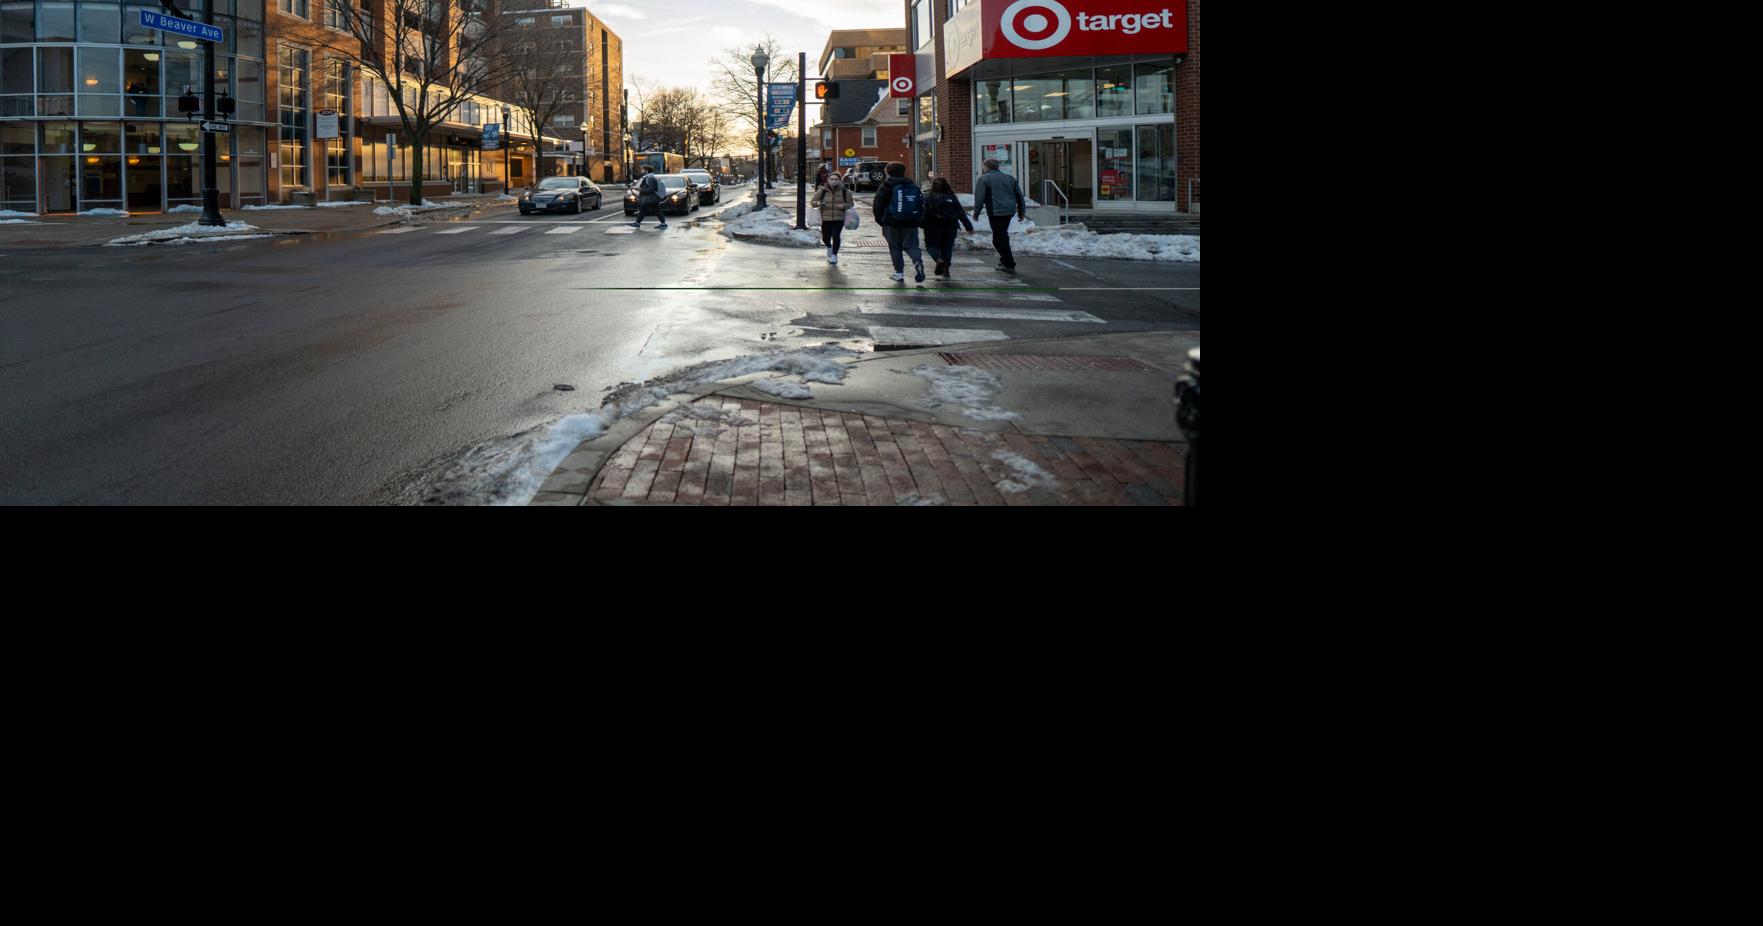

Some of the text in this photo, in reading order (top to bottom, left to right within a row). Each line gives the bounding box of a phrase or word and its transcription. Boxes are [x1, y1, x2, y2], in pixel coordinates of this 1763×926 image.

[144, 13, 219, 38] W Beaver Ave
[1076, 8, 1173, 35] target
